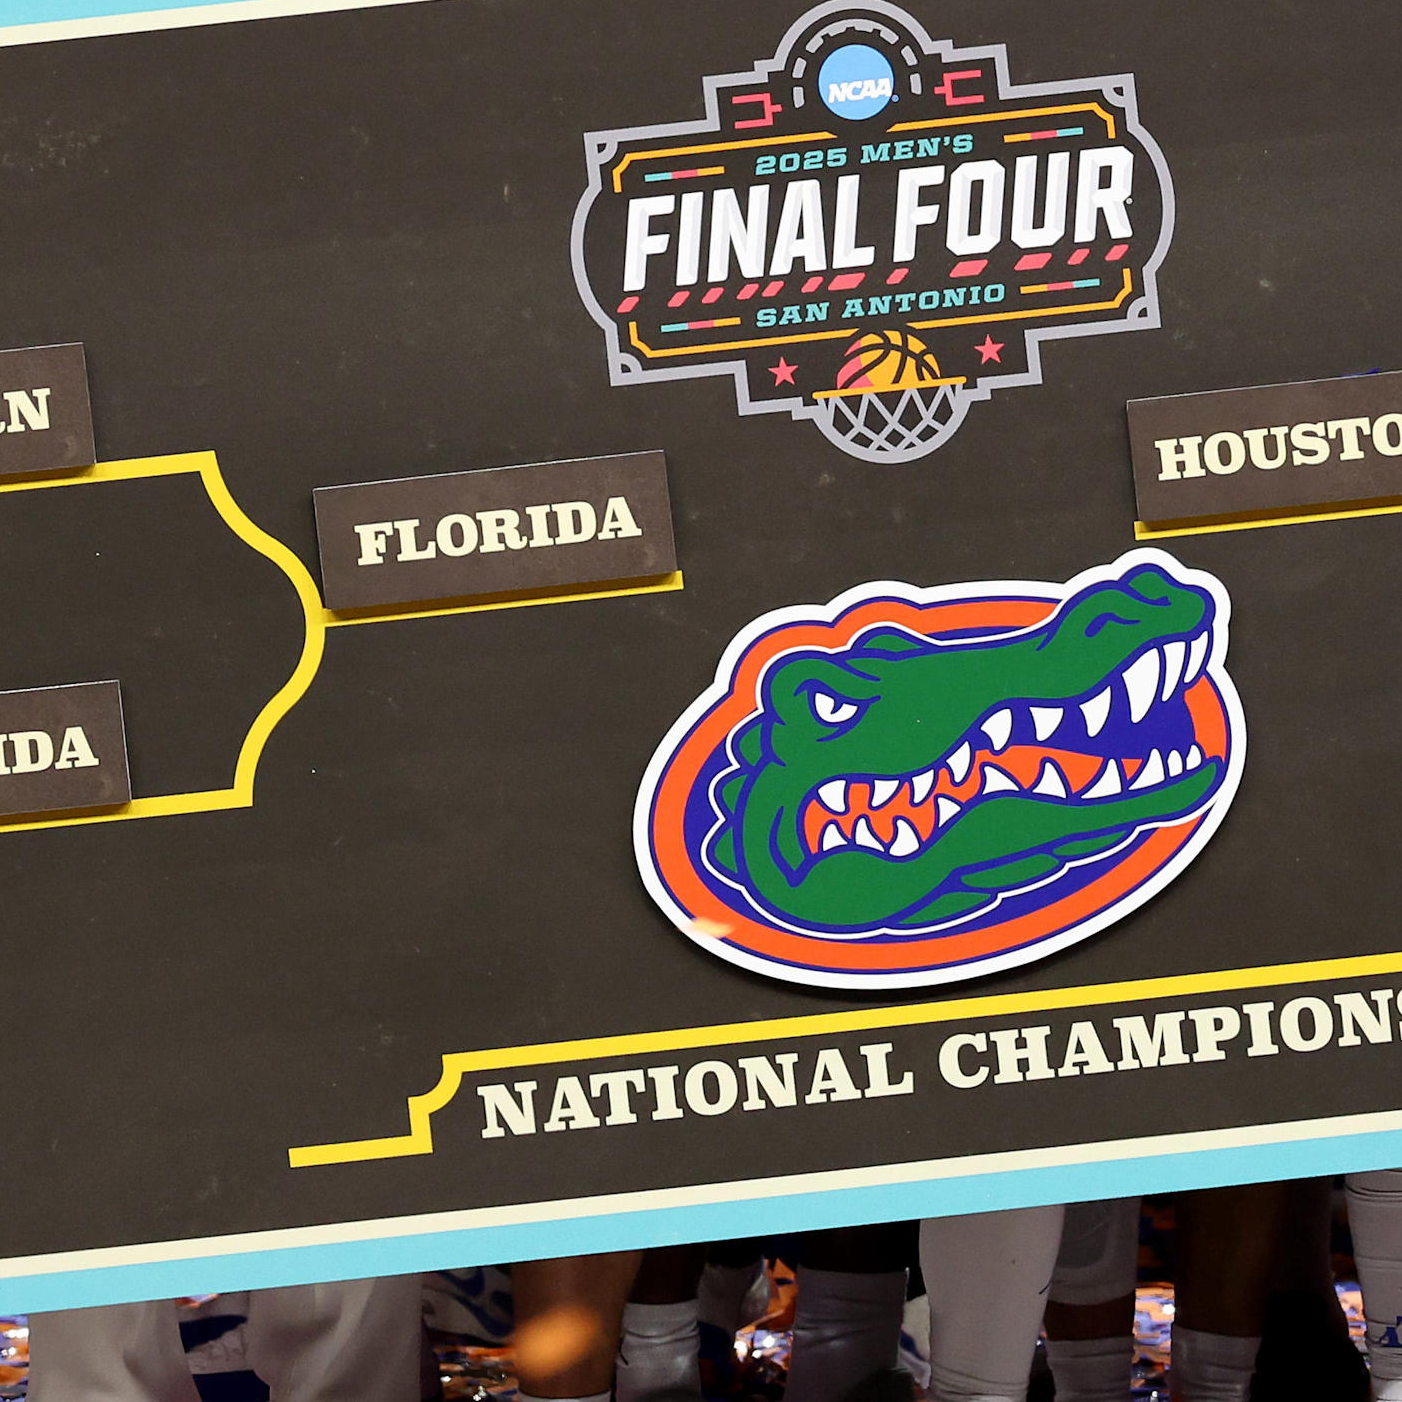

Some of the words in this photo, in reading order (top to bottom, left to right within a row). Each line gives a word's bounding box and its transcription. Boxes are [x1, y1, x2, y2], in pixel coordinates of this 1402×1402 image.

[828, 77, 892, 103] NCAA
[755, 147, 848, 176] 2025
[860, 134, 974, 164] MEN'S
[623, 174, 876, 293] FINAL
[893, 145, 1134, 262] FOUR
[756, 300, 830, 328] SAN
[844, 283, 1006, 318] ANTONIO
[354, 496, 642, 566] FLORIDA
[477, 1043, 914, 1139] NATIONAL
